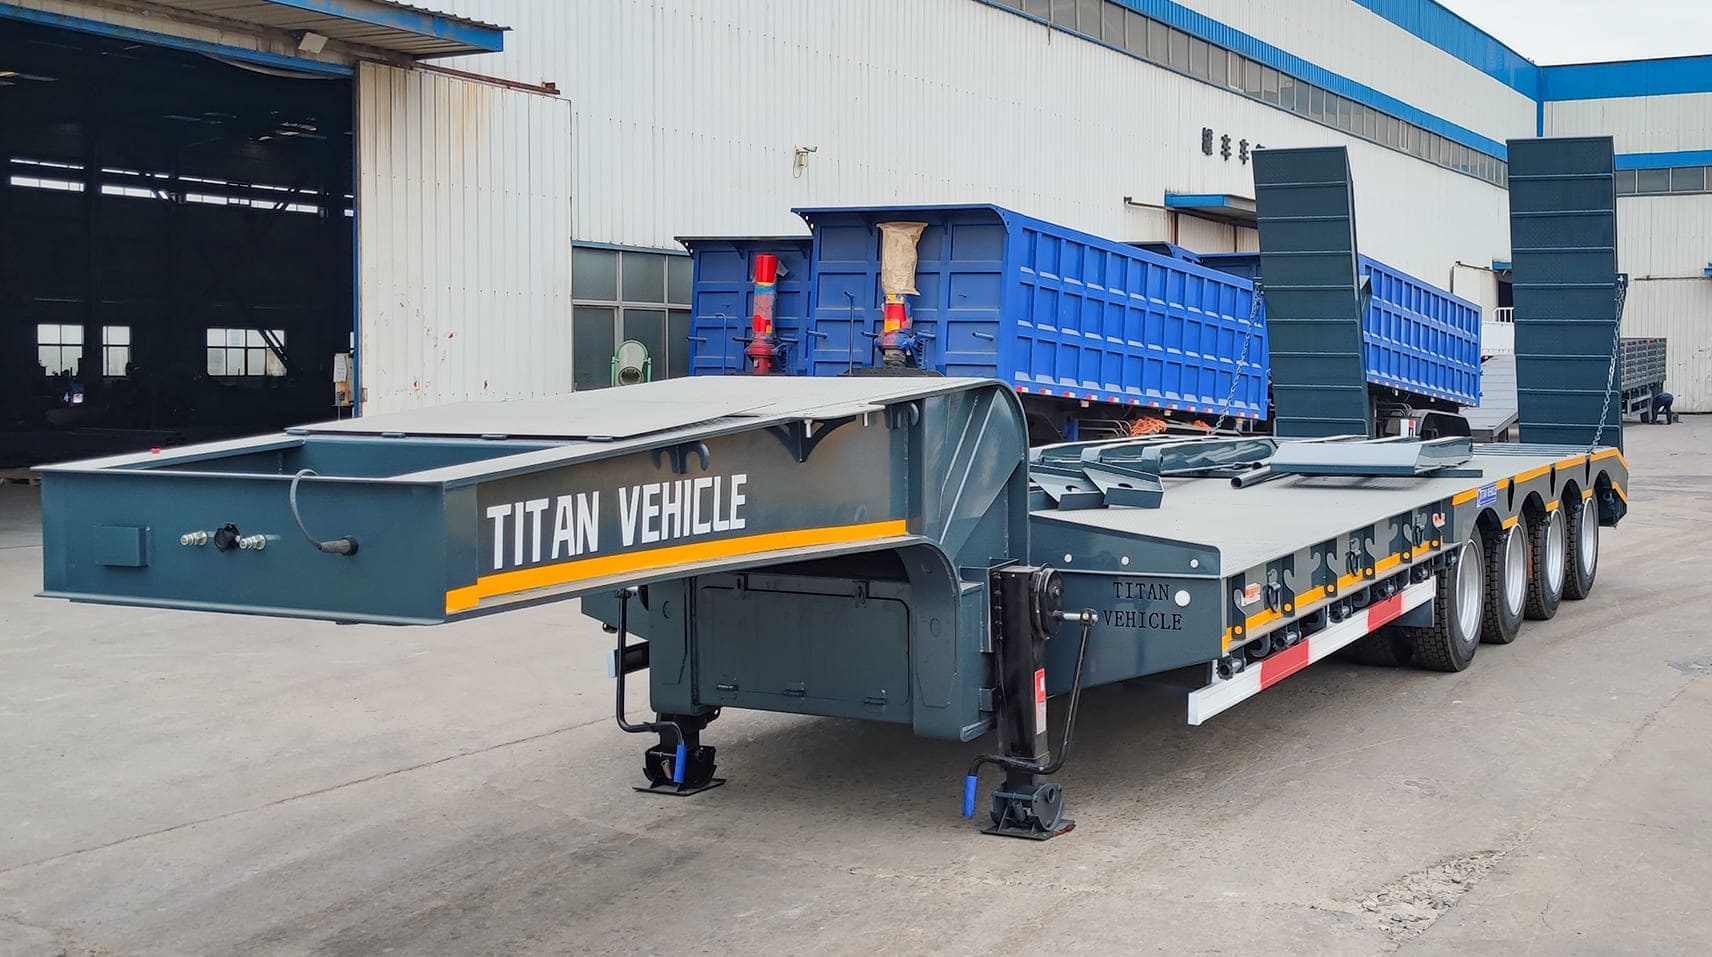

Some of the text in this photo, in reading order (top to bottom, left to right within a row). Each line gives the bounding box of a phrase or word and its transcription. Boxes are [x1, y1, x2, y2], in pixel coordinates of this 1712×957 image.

[486, 473, 747, 570] TITAN VEHICLE
[1112, 581, 1170, 601] TITAN
[1103, 609, 1183, 631] VEHICLE
